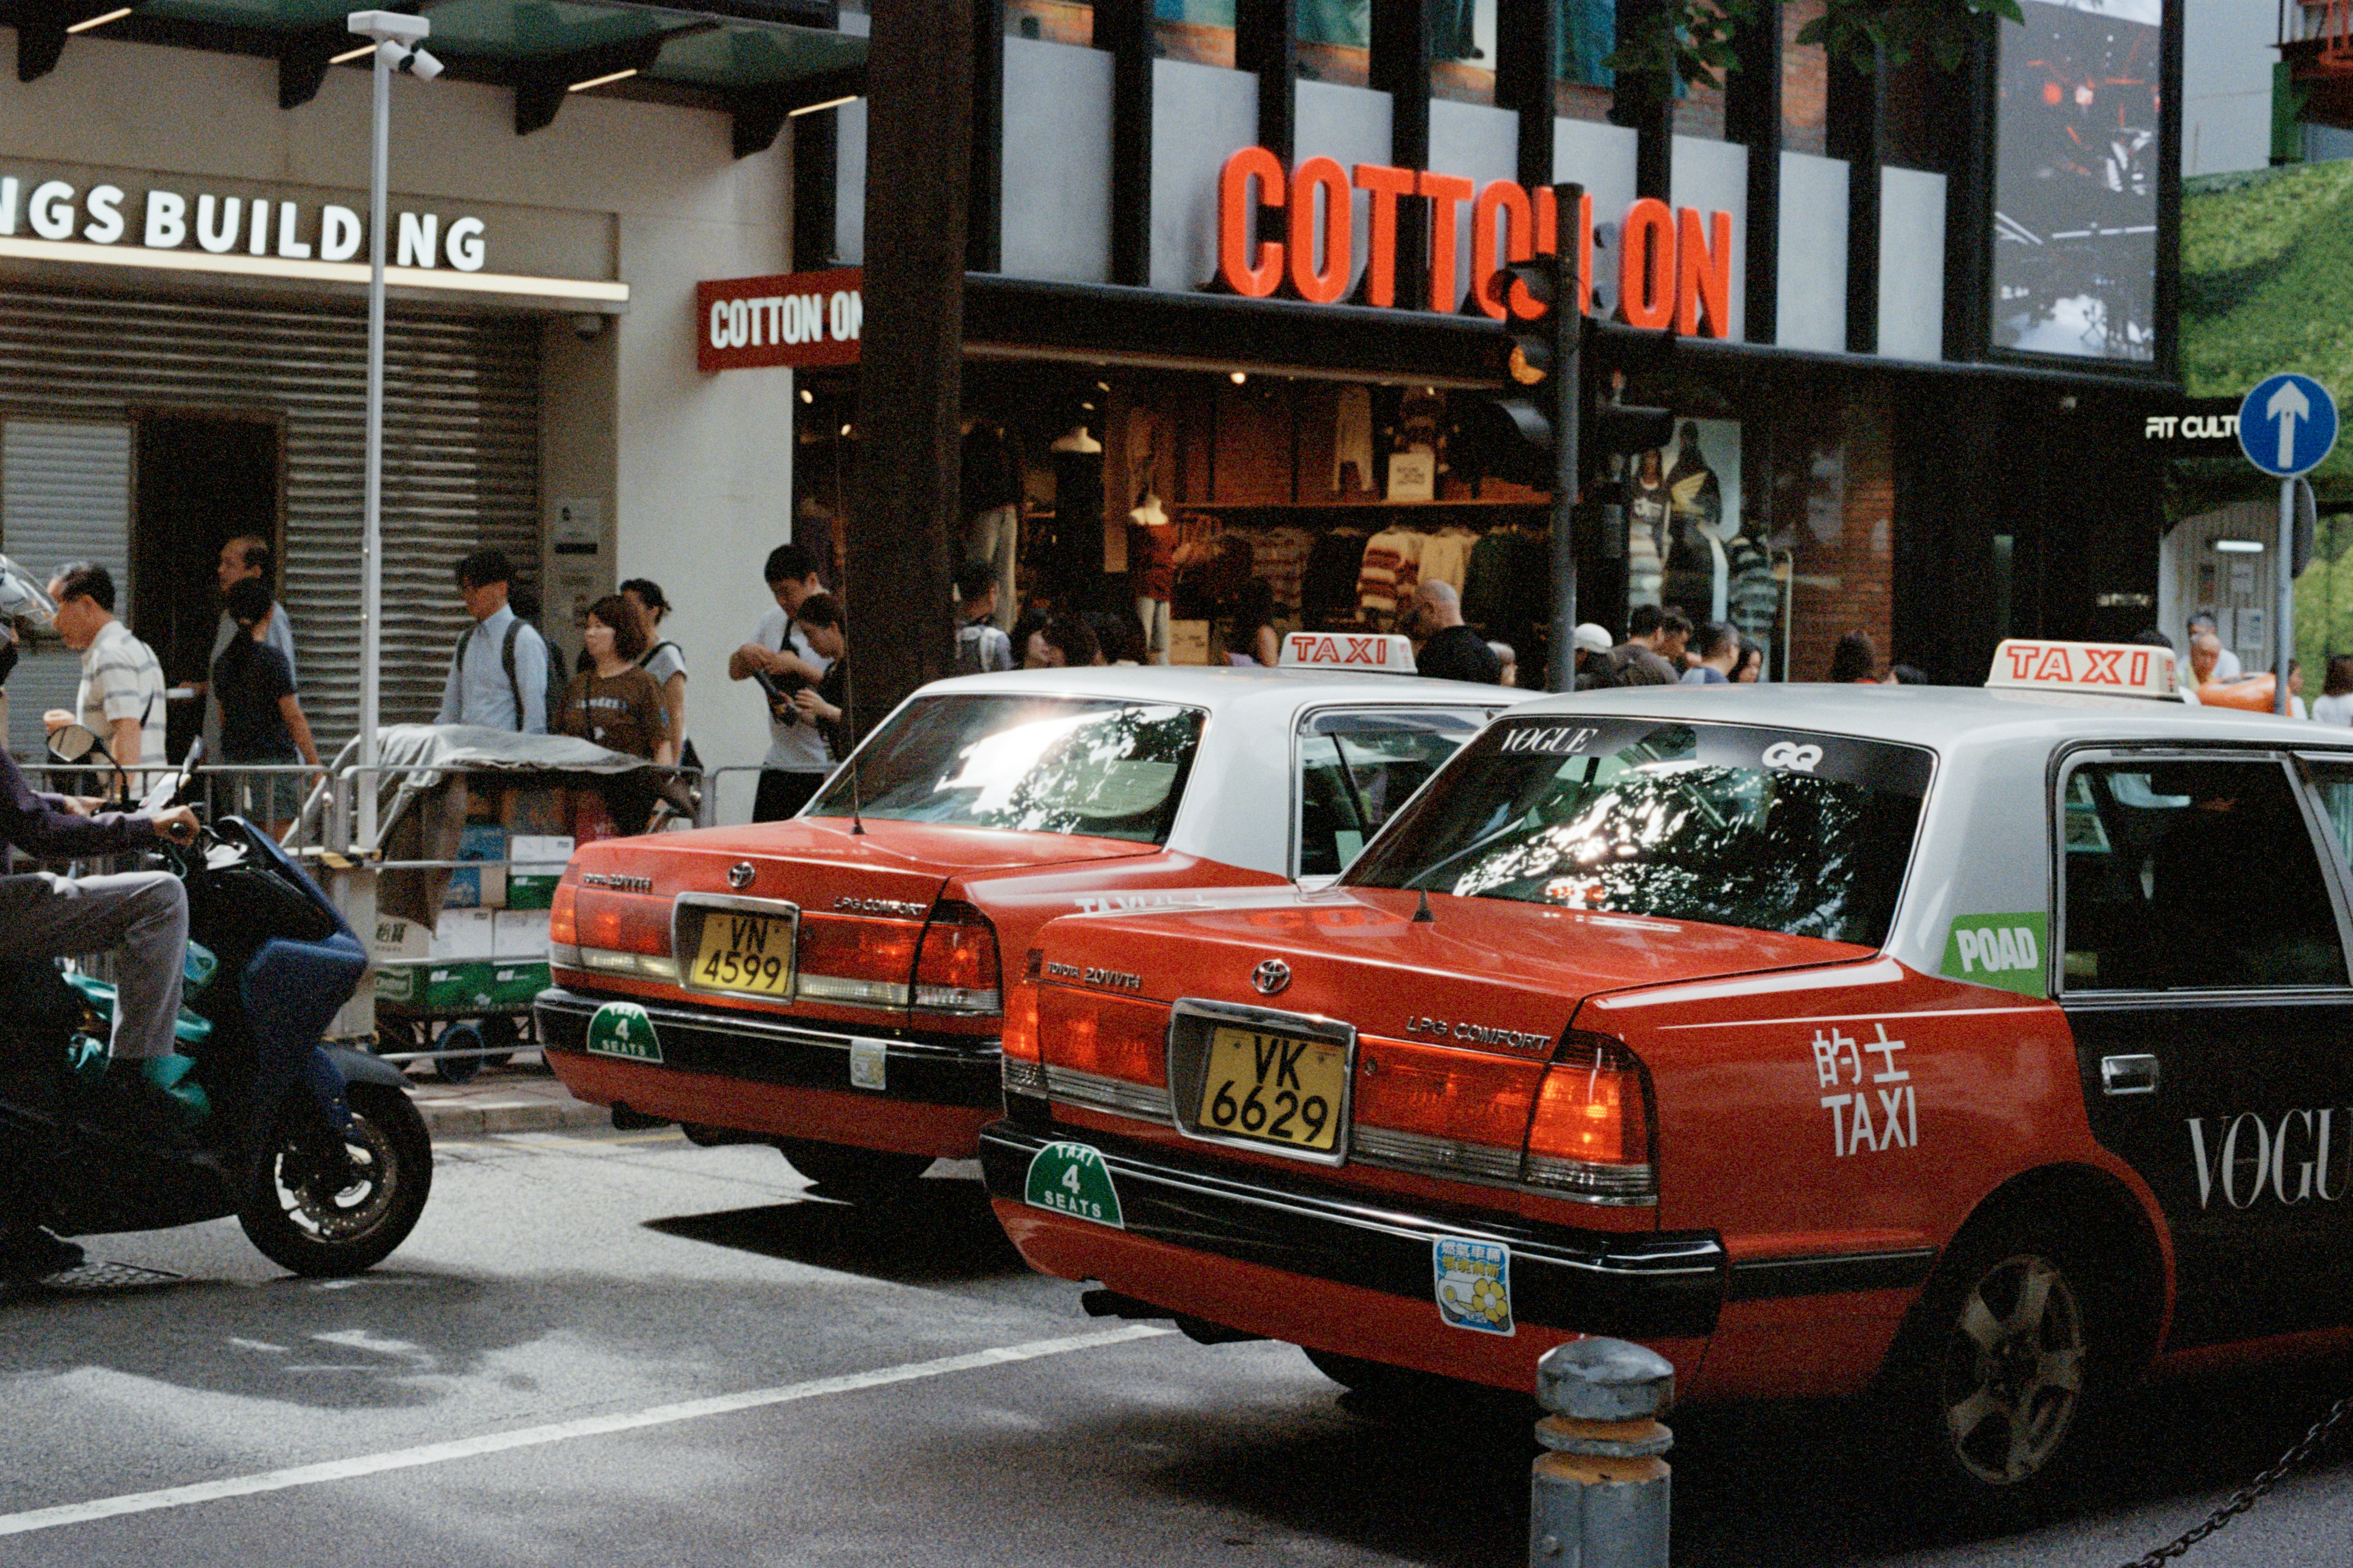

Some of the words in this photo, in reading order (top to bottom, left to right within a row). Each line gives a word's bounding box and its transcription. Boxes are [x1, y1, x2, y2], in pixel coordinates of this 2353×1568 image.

[144, 190, 485, 272] BUILDNG
[1617, 197, 1732, 339] ON
[710, 293, 822, 349] COTTON
[1291, 636, 1387, 665] TAXI
[2006, 645, 2149, 686] TAXI
[1500, 728, 1598, 753] VOGUE
[1762, 741, 1823, 773] GQ
[732, 917, 769, 954] VN
[1955, 927, 2039, 973] POAD
[703, 949, 781, 989] 4599
[602, 1039, 646, 1057] SEATS
[615, 1018, 629, 1040] 4
[1406, 1016, 1448, 1036] LPG
[1453, 1022, 1552, 1050] COMFORT
[1254, 1035, 1308, 1091] VK
[1812, 1022, 1910, 1089] 的士
[1211, 1079, 1328, 1142] 6629
[1820, 1085, 1918, 1157] TAXI
[1055, 1143, 1096, 1167] TAXI
[2184, 1107, 2353, 1210] VOGU
[1061, 1164, 1080, 1194] 4
[1044, 1190, 1101, 1218] SEATS
